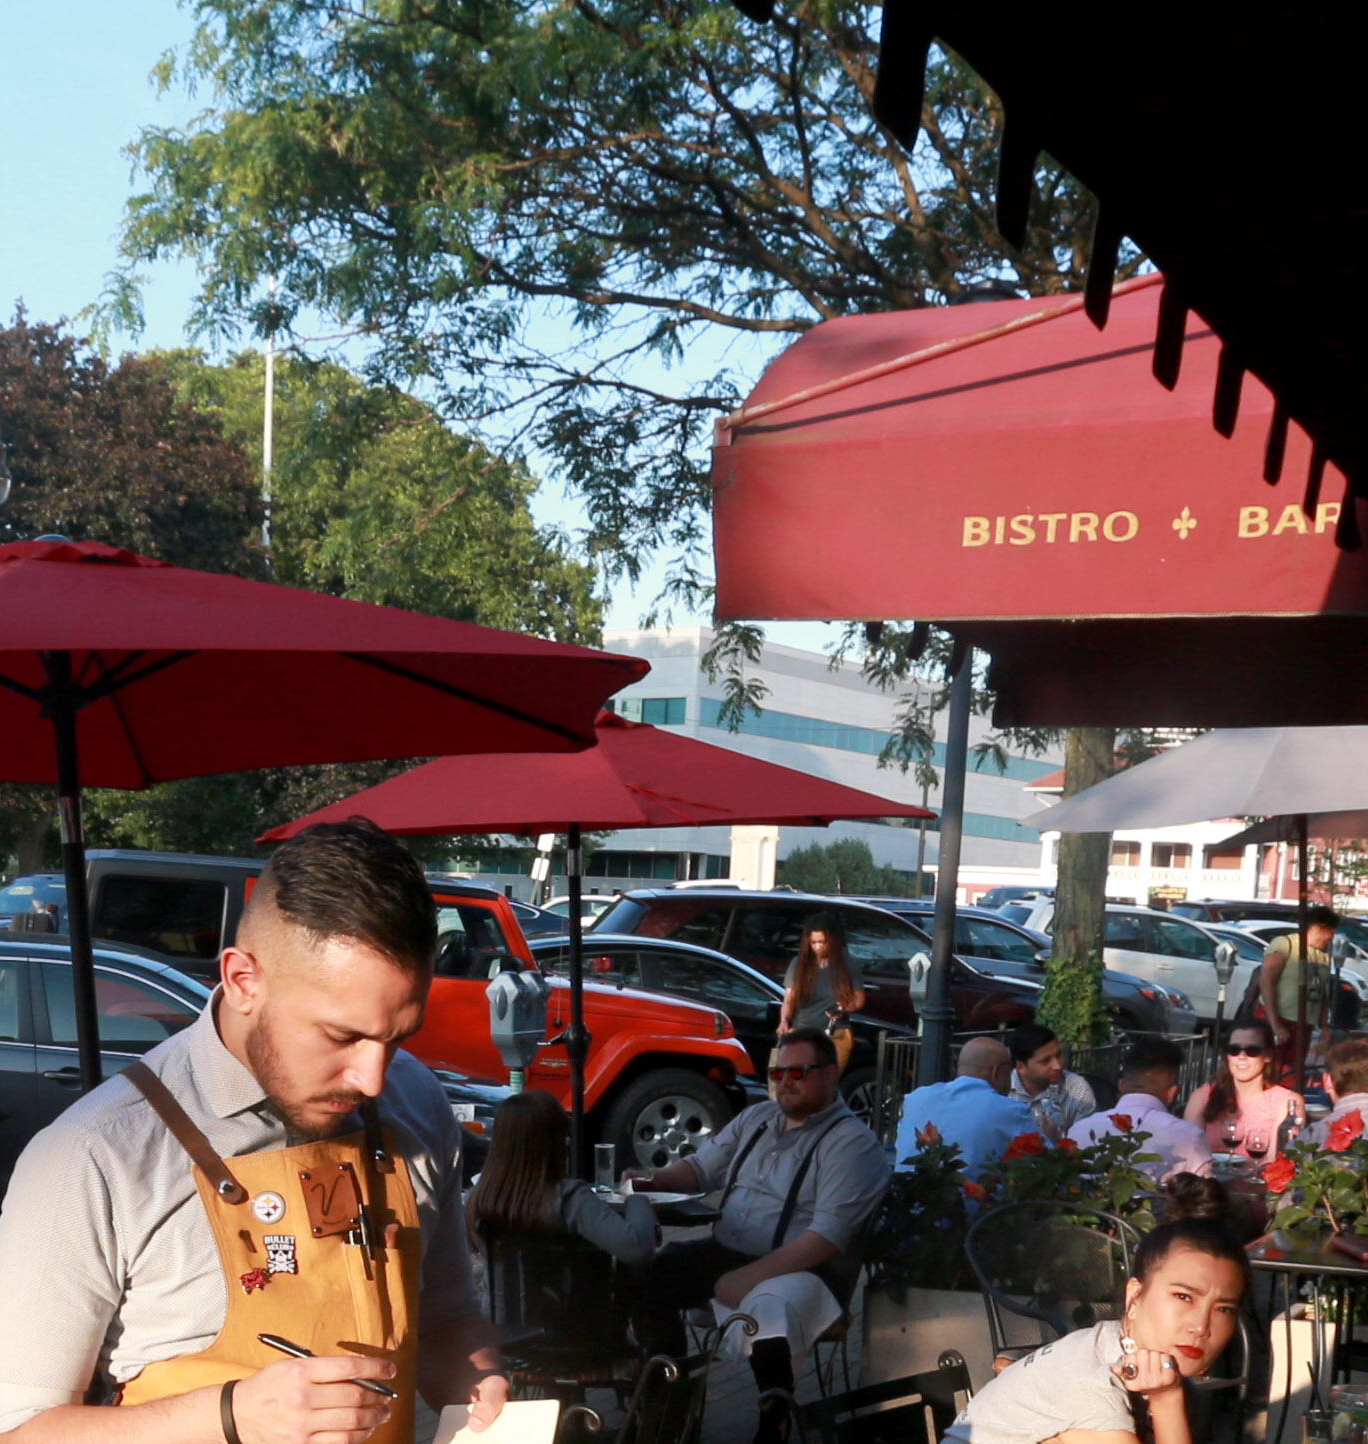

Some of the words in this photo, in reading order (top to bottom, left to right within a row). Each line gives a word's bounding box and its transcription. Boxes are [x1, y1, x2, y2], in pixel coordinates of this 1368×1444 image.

[961, 509, 1140, 548] BISTRO
[1237, 501, 1342, 538] BAR
[264, 1235, 296, 1245] BULLET
